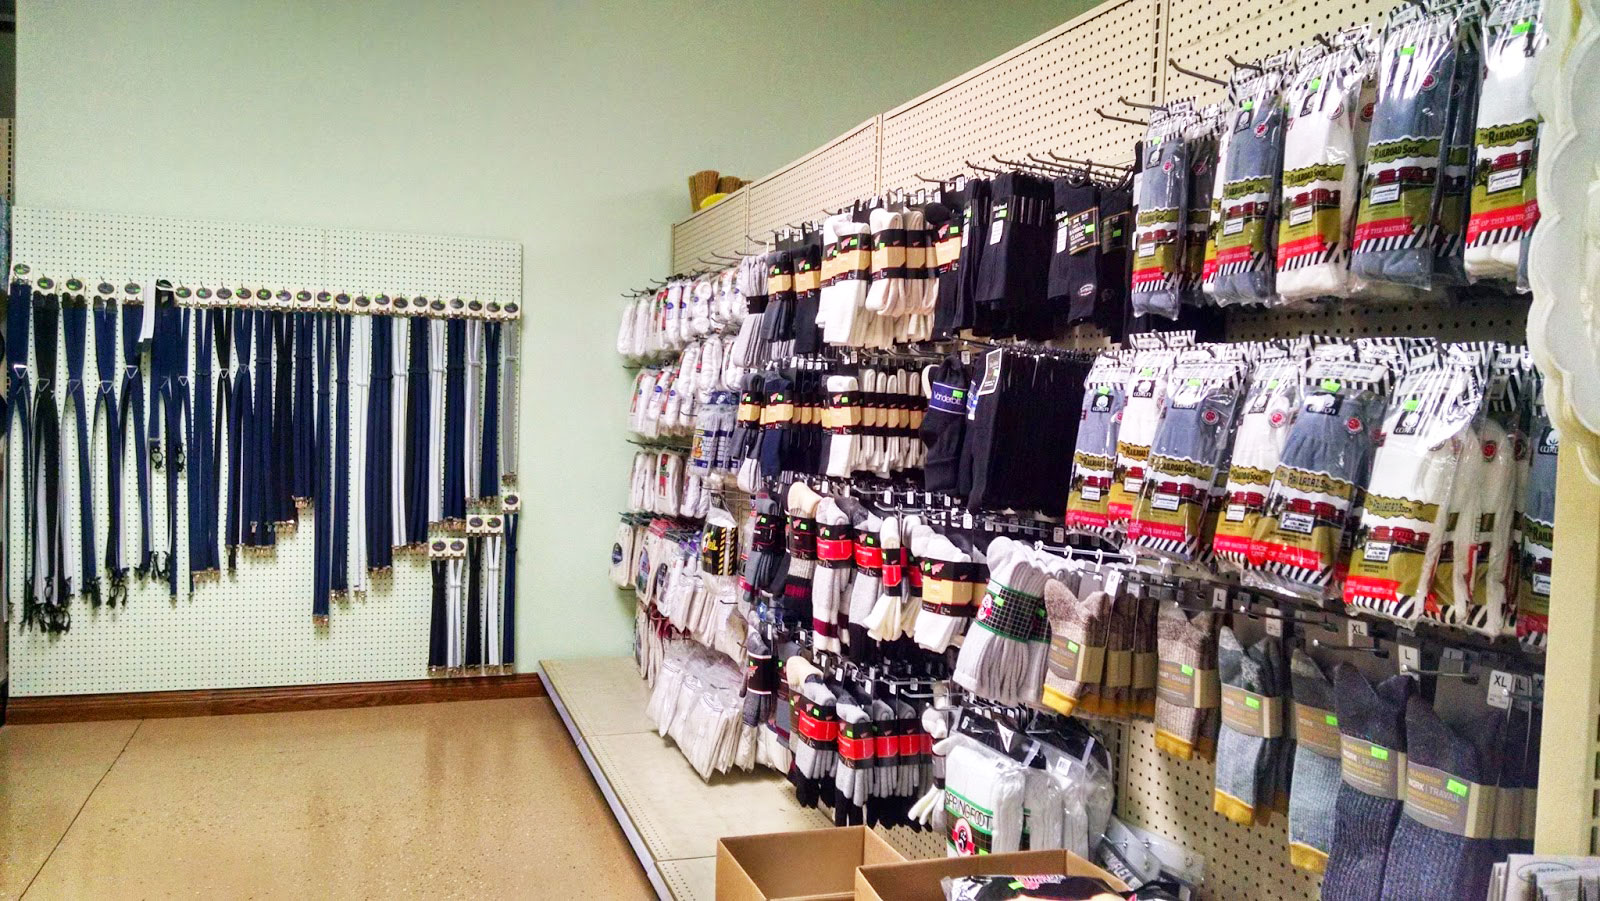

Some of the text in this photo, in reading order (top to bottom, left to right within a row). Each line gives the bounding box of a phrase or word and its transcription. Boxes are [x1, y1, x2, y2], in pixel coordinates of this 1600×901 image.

[1488, 126, 1526, 144] RAILROAD
[1402, 144, 1420, 155] SOCK
[1352, 623, 1364, 634] XL
[1405, 649, 1411, 660] L
[1493, 674, 1507, 688] XL
[944, 789, 993, 830] SPRINGFOOT
